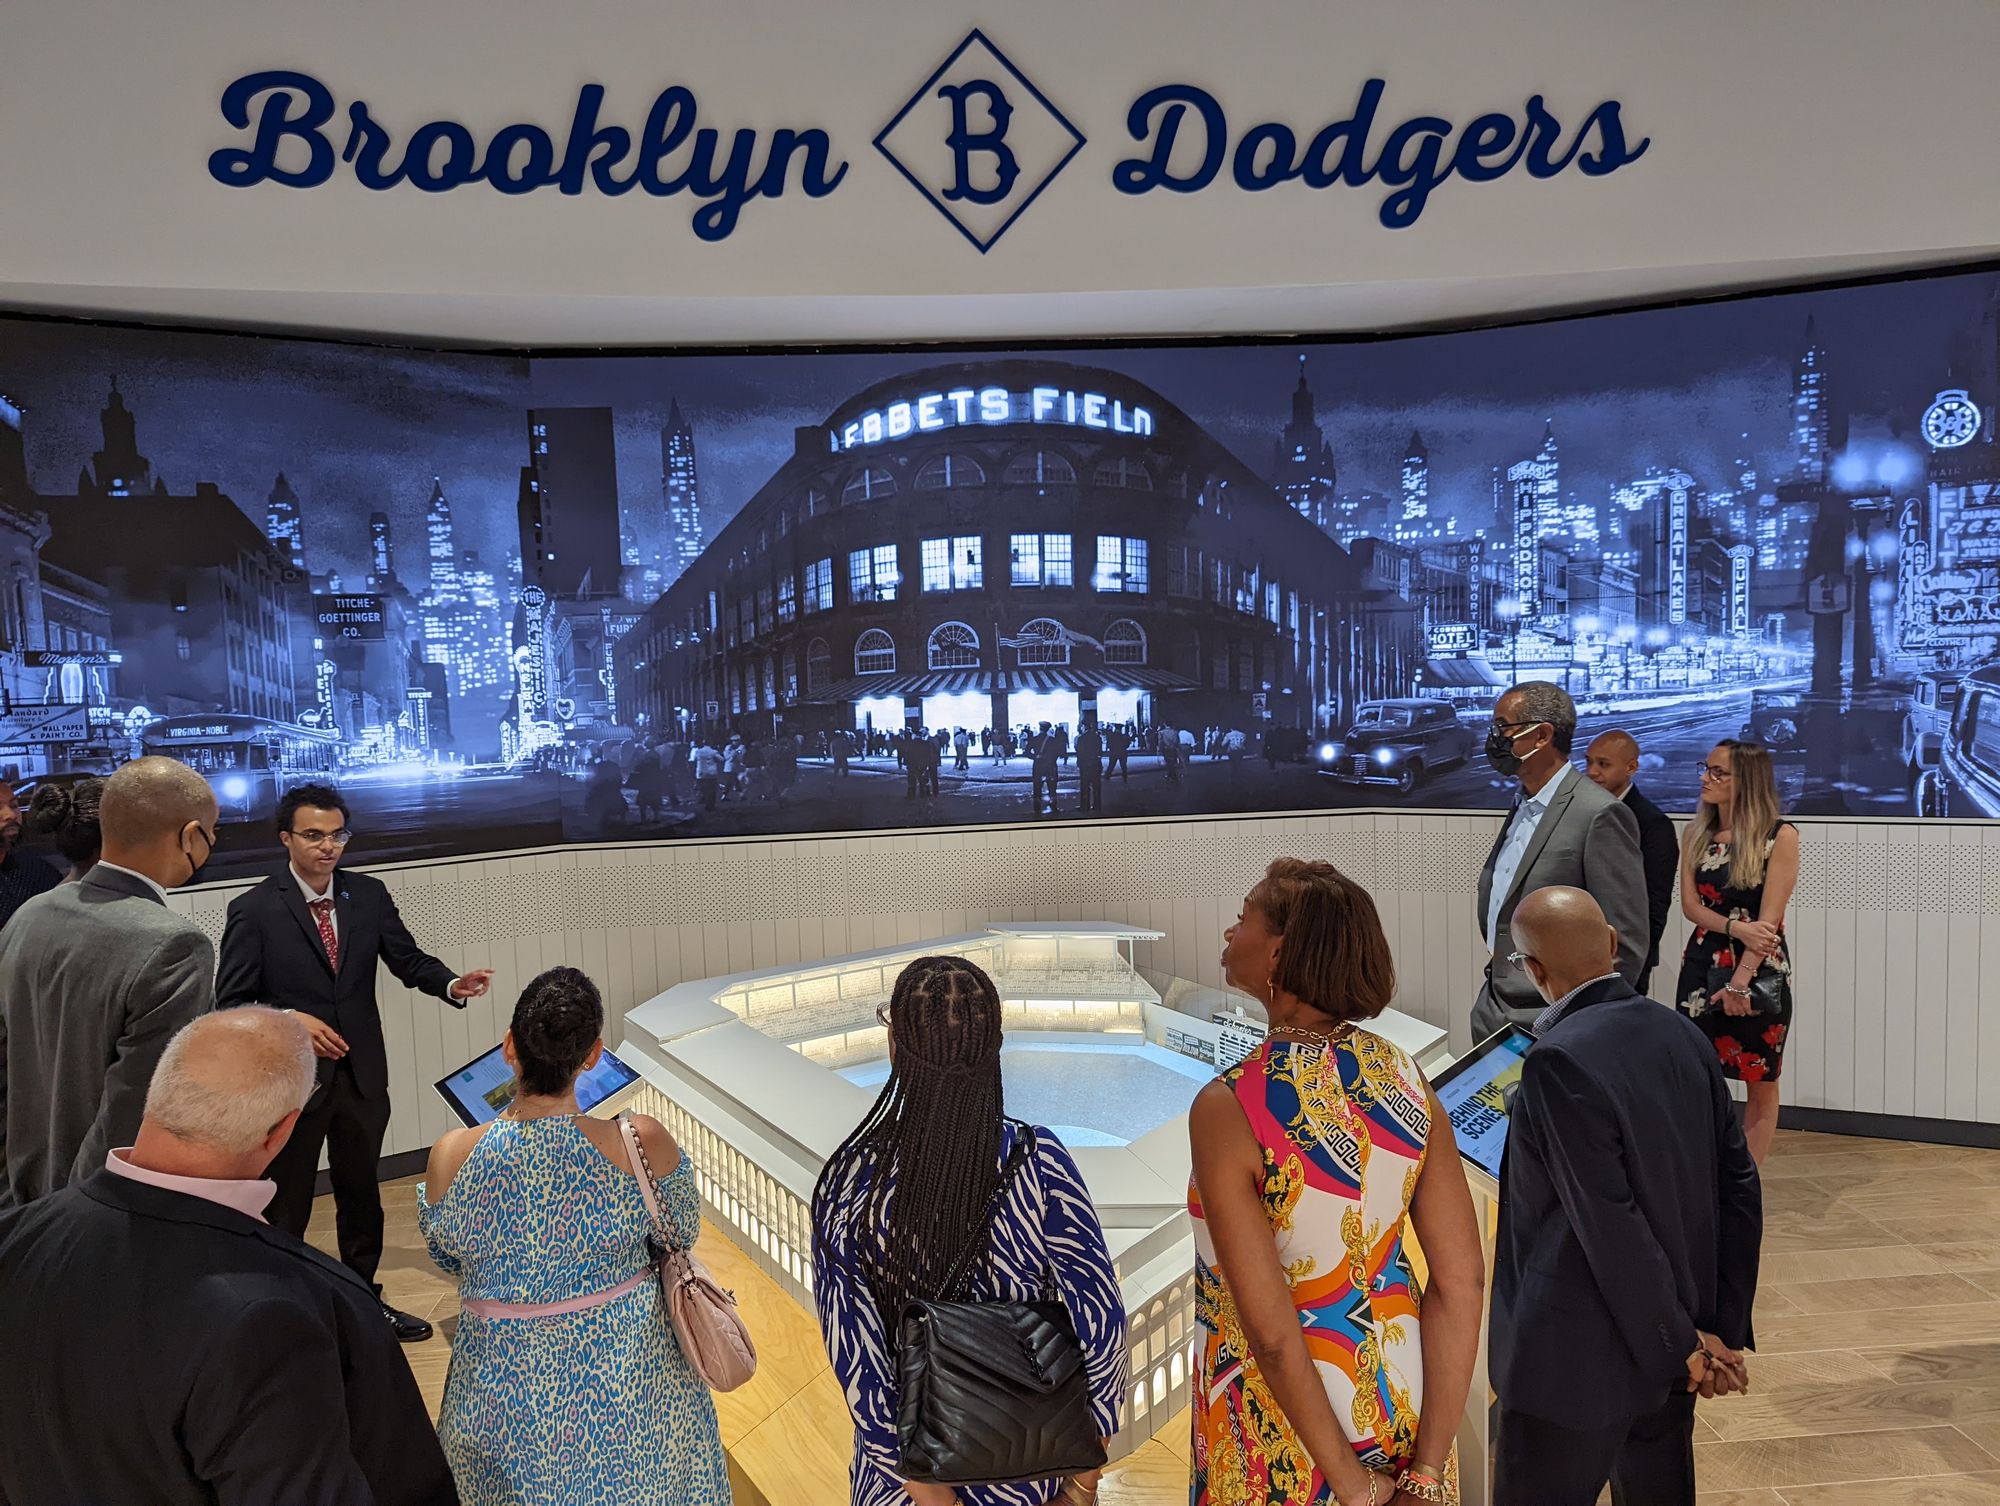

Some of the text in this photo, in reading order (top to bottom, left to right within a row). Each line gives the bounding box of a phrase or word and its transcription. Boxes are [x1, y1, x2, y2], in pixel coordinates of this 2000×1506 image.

[208, 70, 1651, 242] Brooklyn B Dodgers
[1519, 481, 1533, 615] HIPPODROME
[1672, 493, 1684, 555] GREAT
[335, 598, 375, 608] TITCHE-
[524, 591, 542, 603] THE
[1671, 560, 1684, 621] LAKES
[318, 612, 381, 623] GOETTINGER
[343, 627, 361, 637] CO.
[610, 624, 633, 633] FUR
[1428, 632, 1474, 644] HOTEL
[314, 638, 326, 703] HTEL
[529, 610, 544, 703] MAJESTIC
[605, 643, 615, 703] FURNITURE
[1448, 1095, 1487, 1129] BEHIND
[1476, 1081, 1503, 1101] THE
[1461, 1105, 1506, 1140] SCENES
